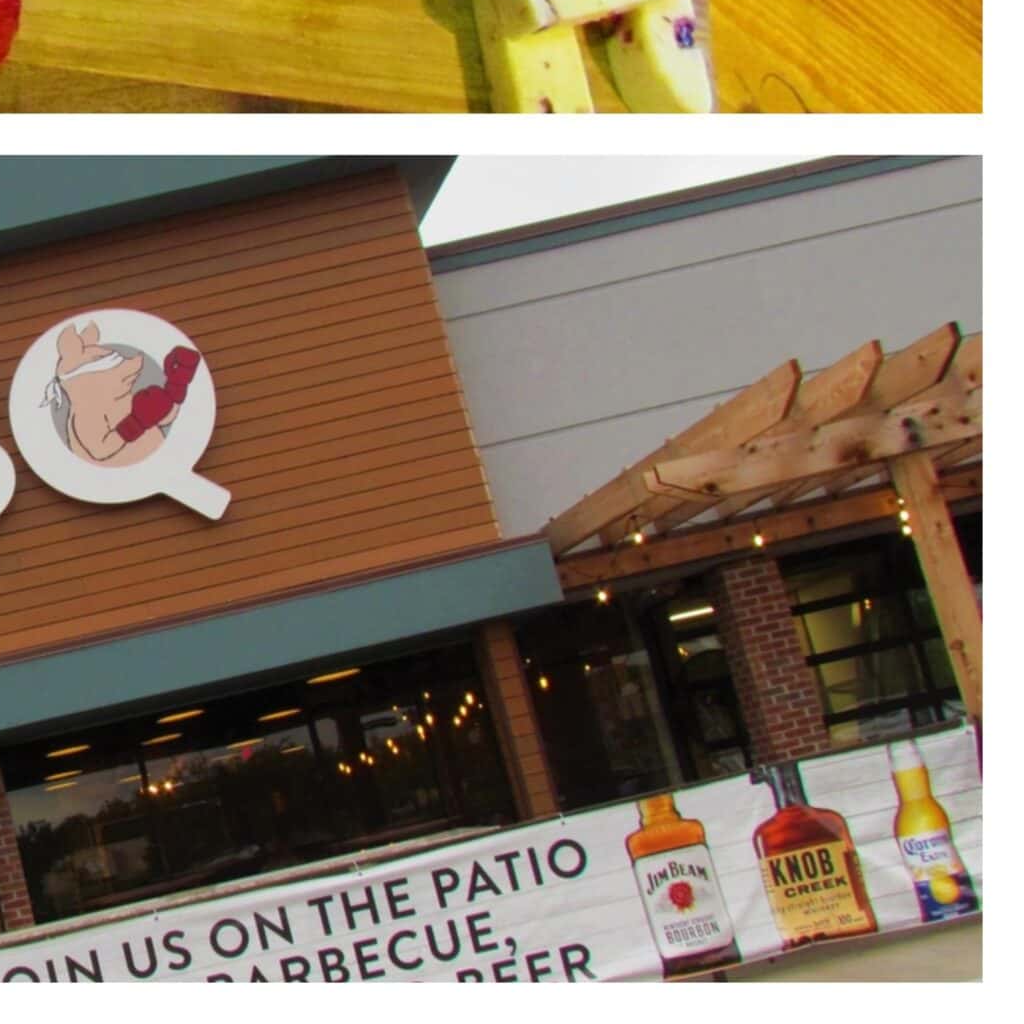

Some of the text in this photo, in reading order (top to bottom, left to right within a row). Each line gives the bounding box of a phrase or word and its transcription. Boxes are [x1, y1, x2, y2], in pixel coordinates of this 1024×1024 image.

[646, 859, 709, 896] JIM BEAM
[768, 847, 835, 887] KNOB
[784, 876, 848, 898] CREEK
[122, 930, 193, 980] US
[209, 906, 295, 959] ON
[307, 876, 417, 936] THE
[430, 837, 588, 910] PATIO
